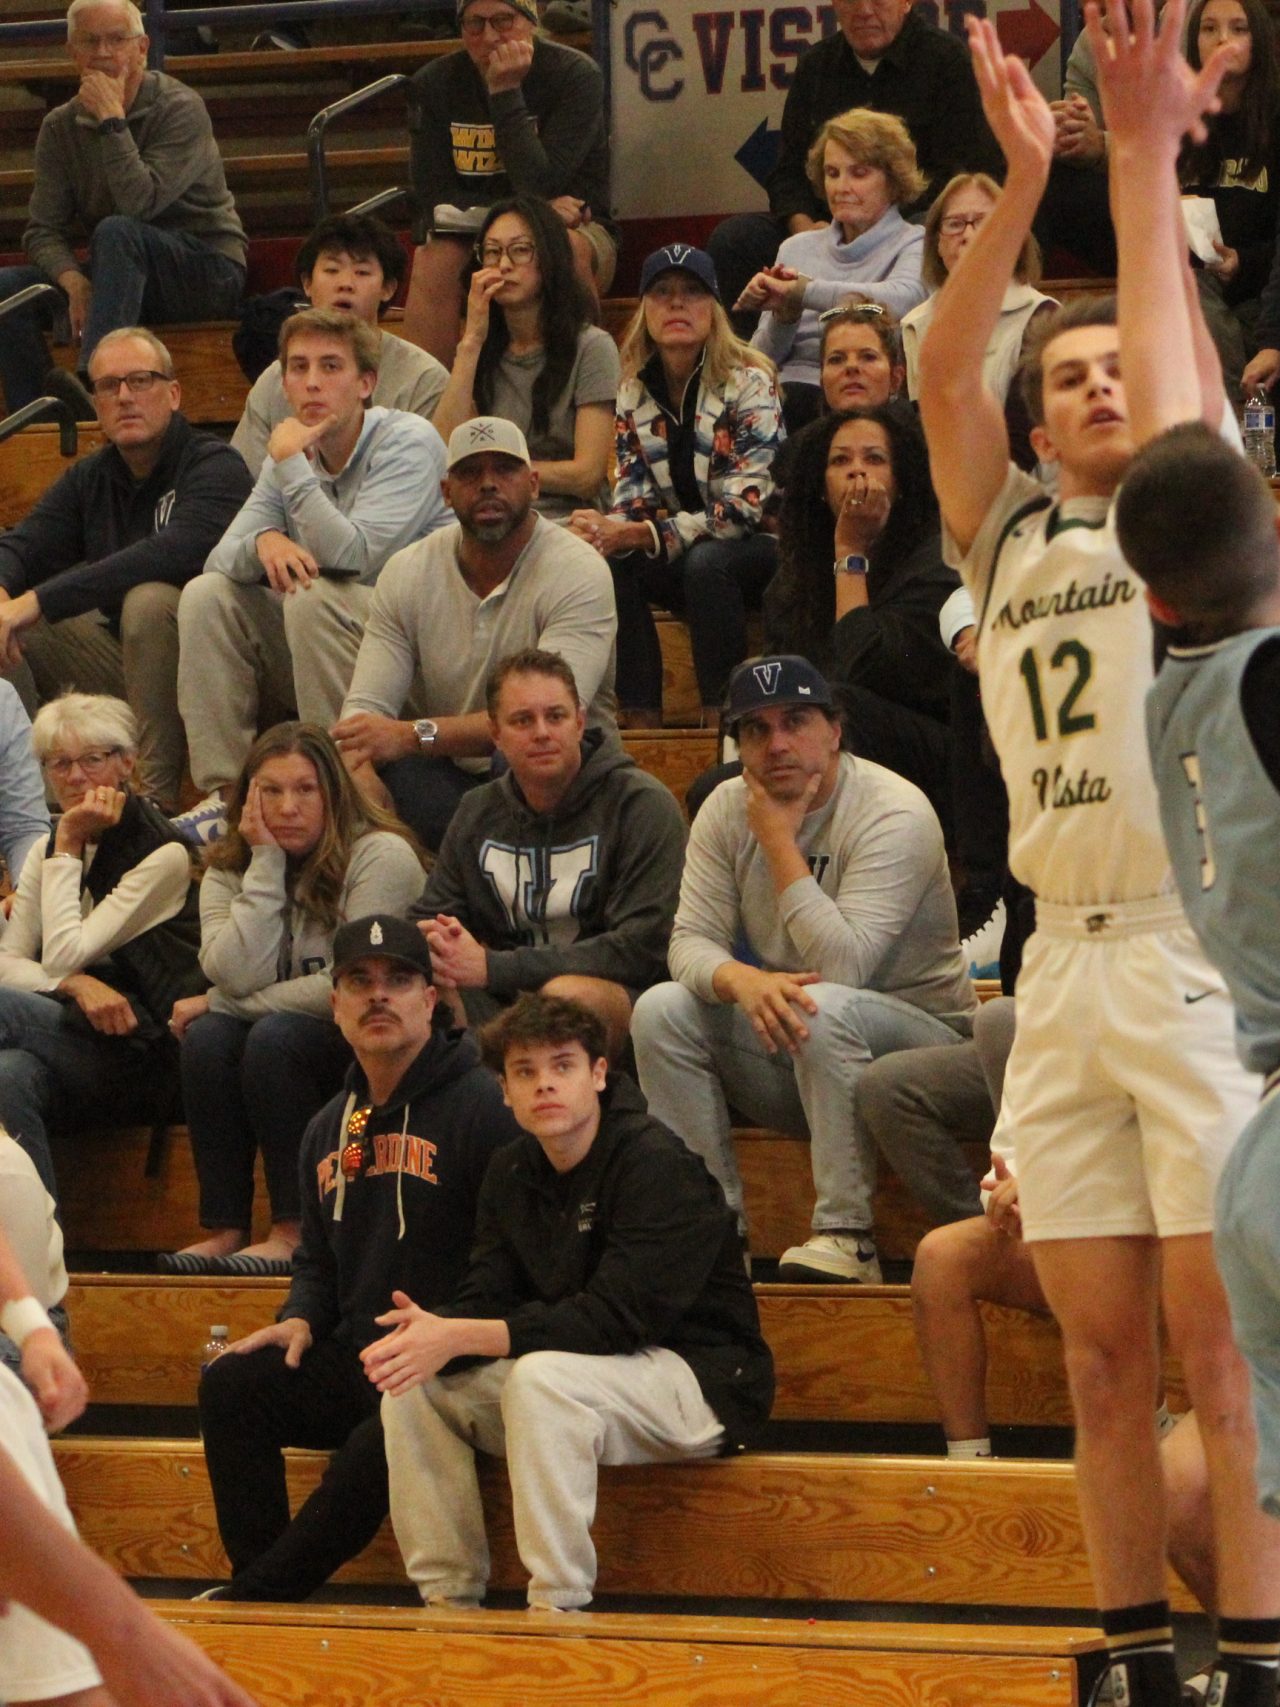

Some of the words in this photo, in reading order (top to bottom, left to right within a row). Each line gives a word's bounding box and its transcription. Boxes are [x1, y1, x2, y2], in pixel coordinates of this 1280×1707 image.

[753, 662, 782, 695] V
[1020, 638, 1096, 741] 12
[317, 1133, 438, 1202] PERDINE
